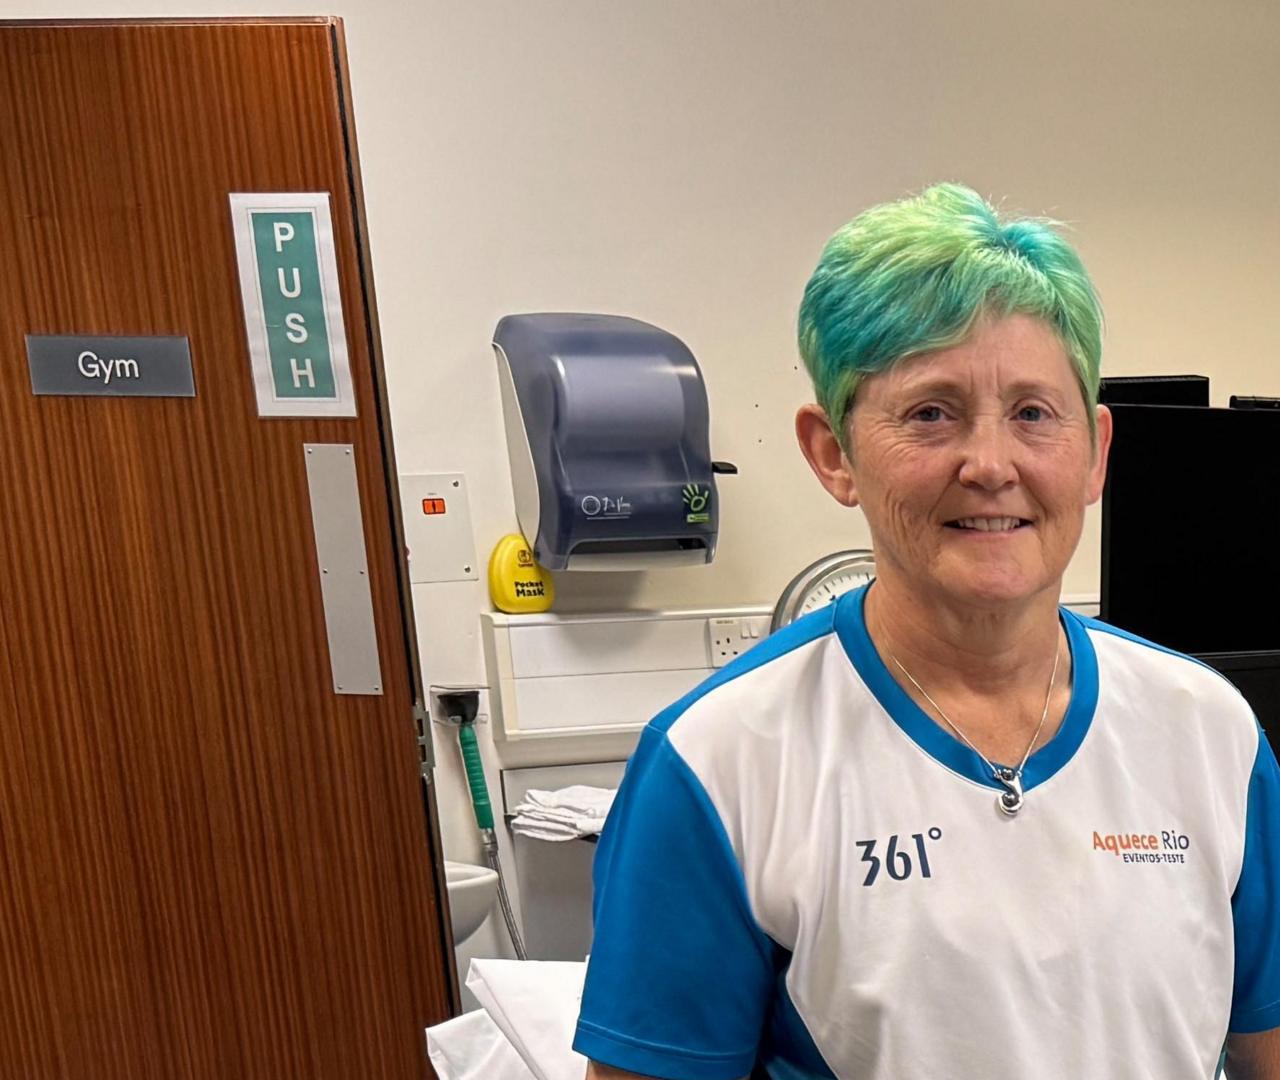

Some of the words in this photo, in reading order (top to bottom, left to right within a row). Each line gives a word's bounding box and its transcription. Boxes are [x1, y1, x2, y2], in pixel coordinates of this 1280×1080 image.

[272, 221, 316, 388] PUSH
[77, 351, 139, 384] Gym
[514, 580, 544, 588] Pocket
[516, 588, 545, 597] Mask
[1093, 830, 1158, 856] Aquece
[1162, 830, 1189, 850] Rio
[1122, 852, 1185, 864] EVENTOS-TESTE
